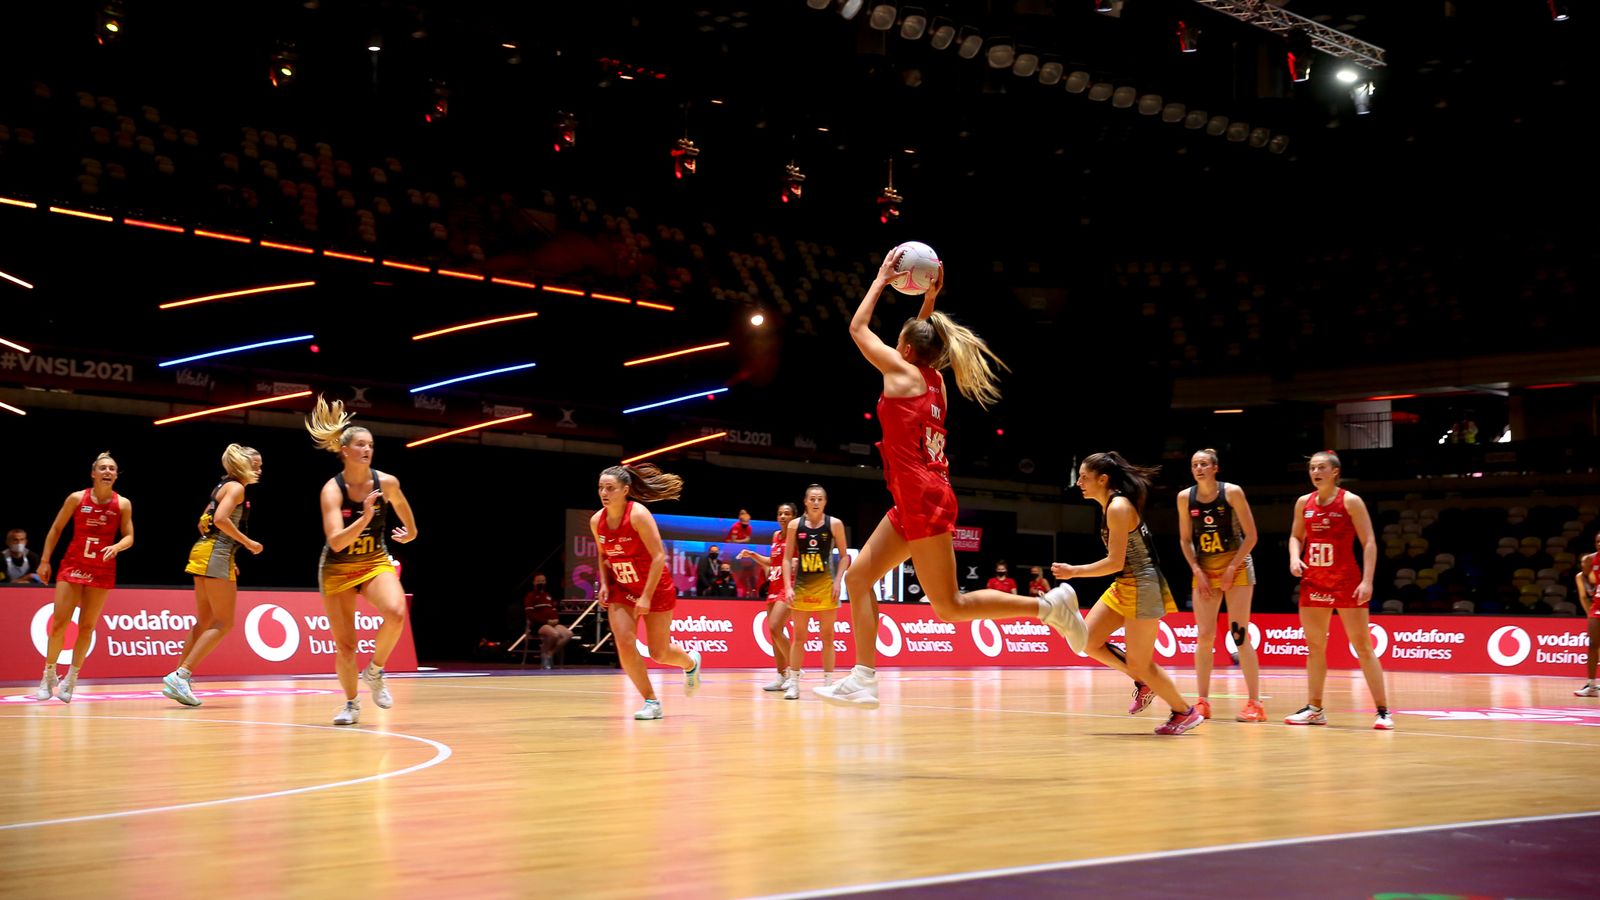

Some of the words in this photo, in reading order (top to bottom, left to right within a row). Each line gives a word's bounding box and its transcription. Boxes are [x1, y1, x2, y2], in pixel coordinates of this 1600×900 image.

[0, 352, 134, 382] #VNSL2021
[84, 537, 99, 559] C
[1200, 532, 1224, 553] GA
[801, 553, 824, 572] WA
[1309, 543, 1334, 567] GD
[612, 562, 639, 584] GA
[103, 610, 198, 631] vodafon
[304, 611, 383, 631] vofon
[902, 619, 956, 635] vodafone
[1001, 621, 1051, 636] vodafone
[1265, 626, 1306, 640] vodaf
[1393, 629, 1465, 644] vodafone
[108, 636, 185, 656] busines
[907, 638, 953, 652] business
[1006, 638, 1049, 653] business
[1263, 642, 1310, 655] busines
[1392, 645, 1453, 660] business
[1536, 646, 1588, 664] busine
